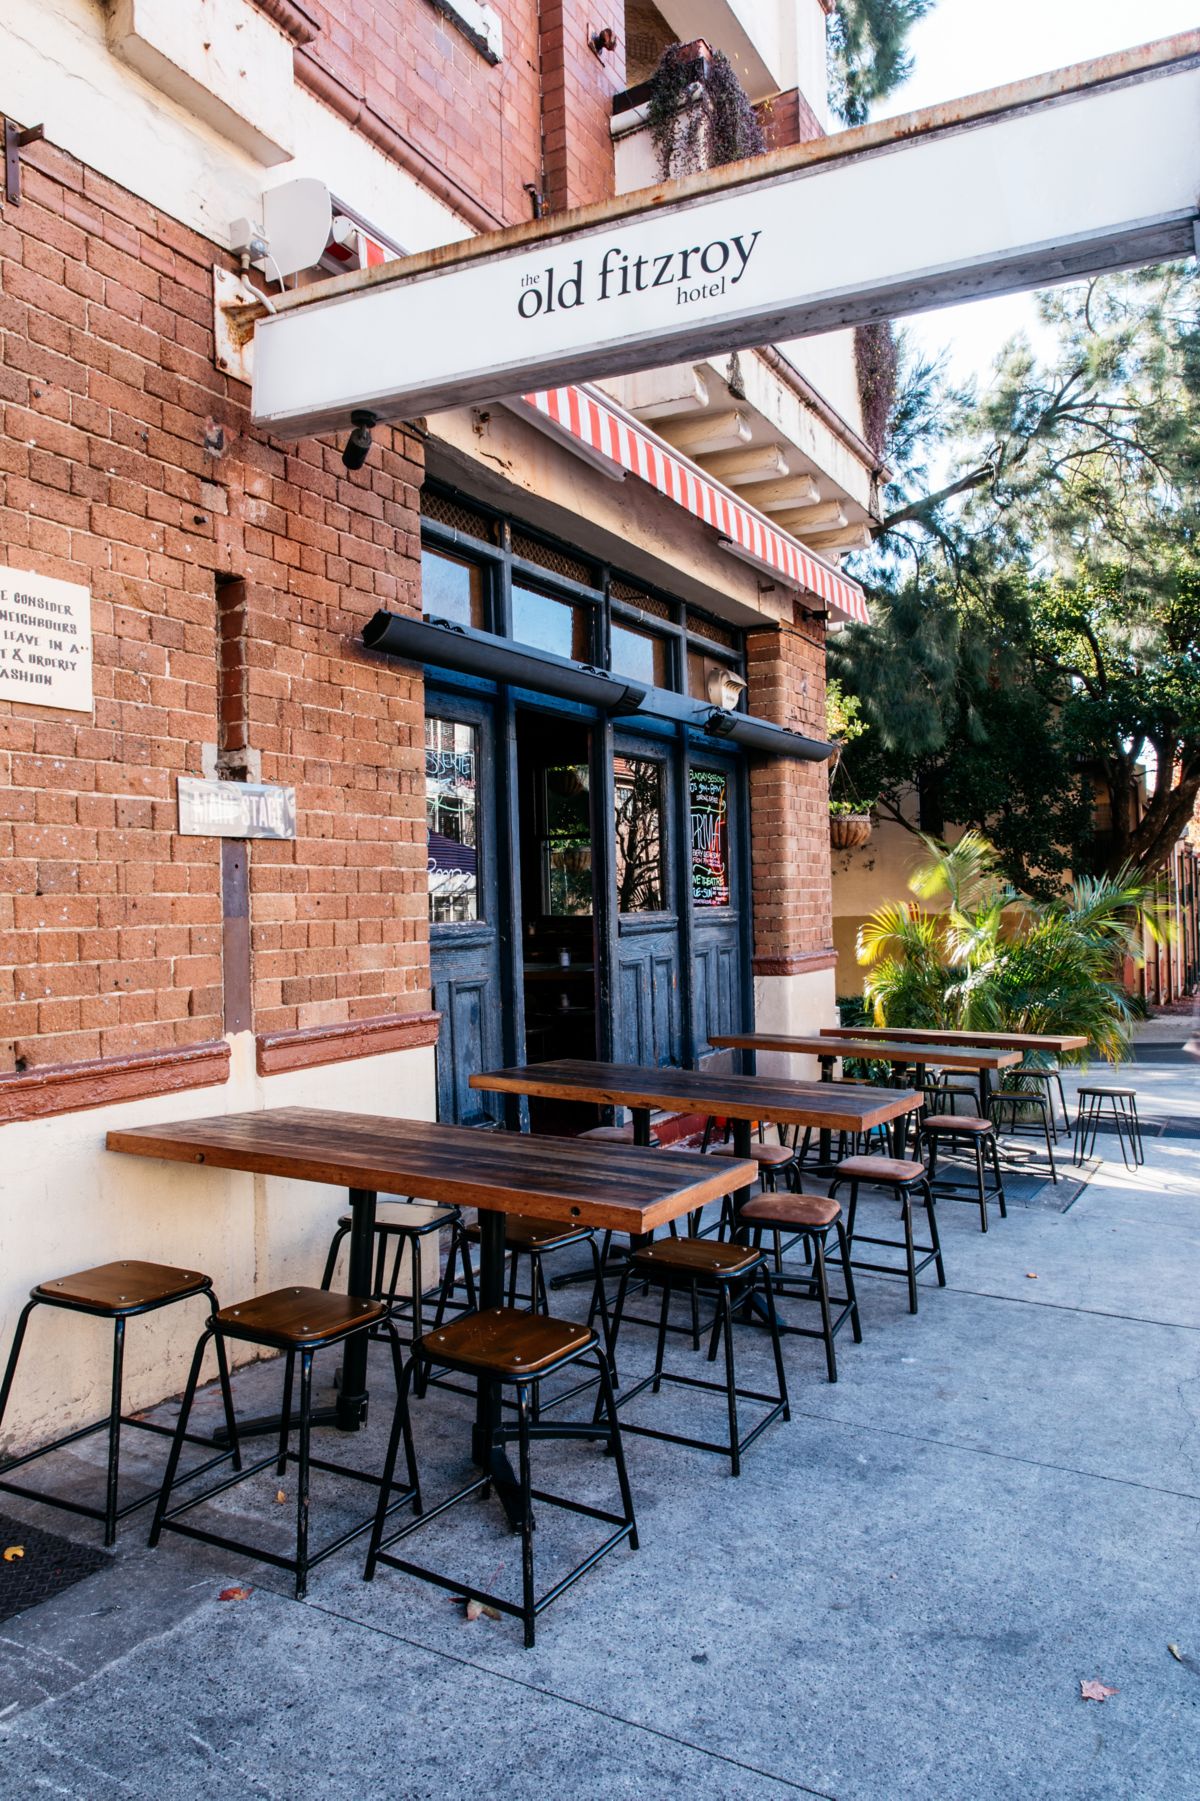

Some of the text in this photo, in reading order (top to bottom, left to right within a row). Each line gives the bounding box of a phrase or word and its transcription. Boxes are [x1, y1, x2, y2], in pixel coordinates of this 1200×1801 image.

[518, 230, 762, 319] old fitzroy
[521, 273, 540, 288] the
[676, 276, 726, 305] hotel
[14, 592, 74, 616] CONSIDER
[0, 609, 78, 635] NEIGHBOURS
[4, 630, 80, 654] LEAVE IN A
[12, 648, 24, 663] &
[29, 653, 77, 671] ORDERLY
[0, 667, 52, 685] ASHION
